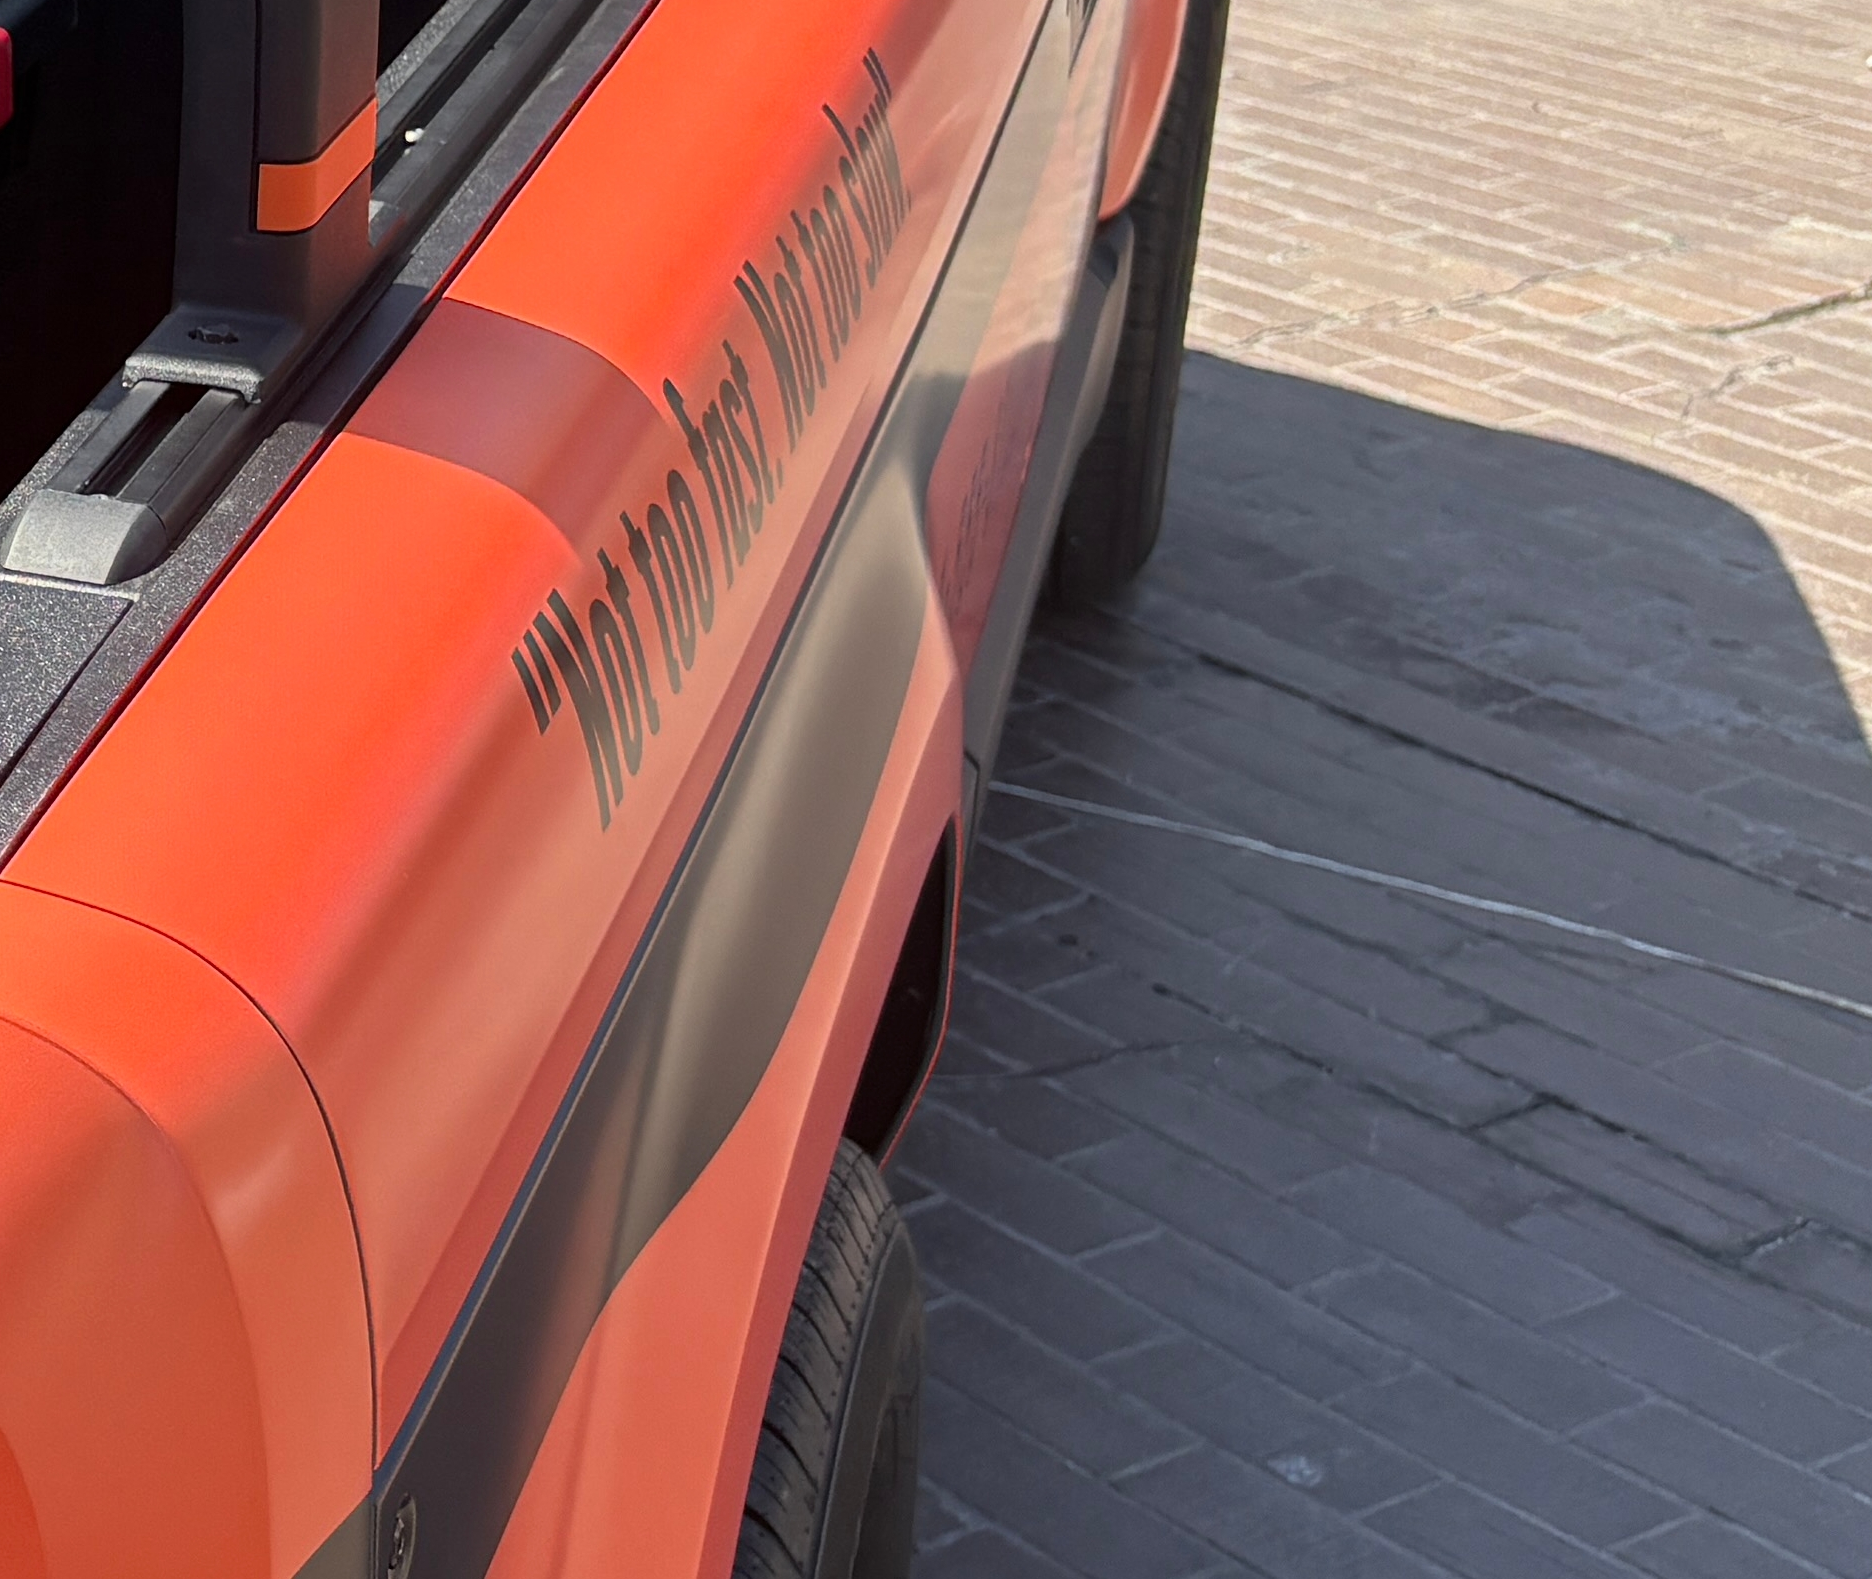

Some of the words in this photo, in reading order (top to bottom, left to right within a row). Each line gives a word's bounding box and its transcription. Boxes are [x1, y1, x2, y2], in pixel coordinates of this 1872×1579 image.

[732, 235, 827, 454] Not
[790, 185, 861, 363] too
[662, 339, 783, 590] fast.
[620, 468, 715, 695] too
